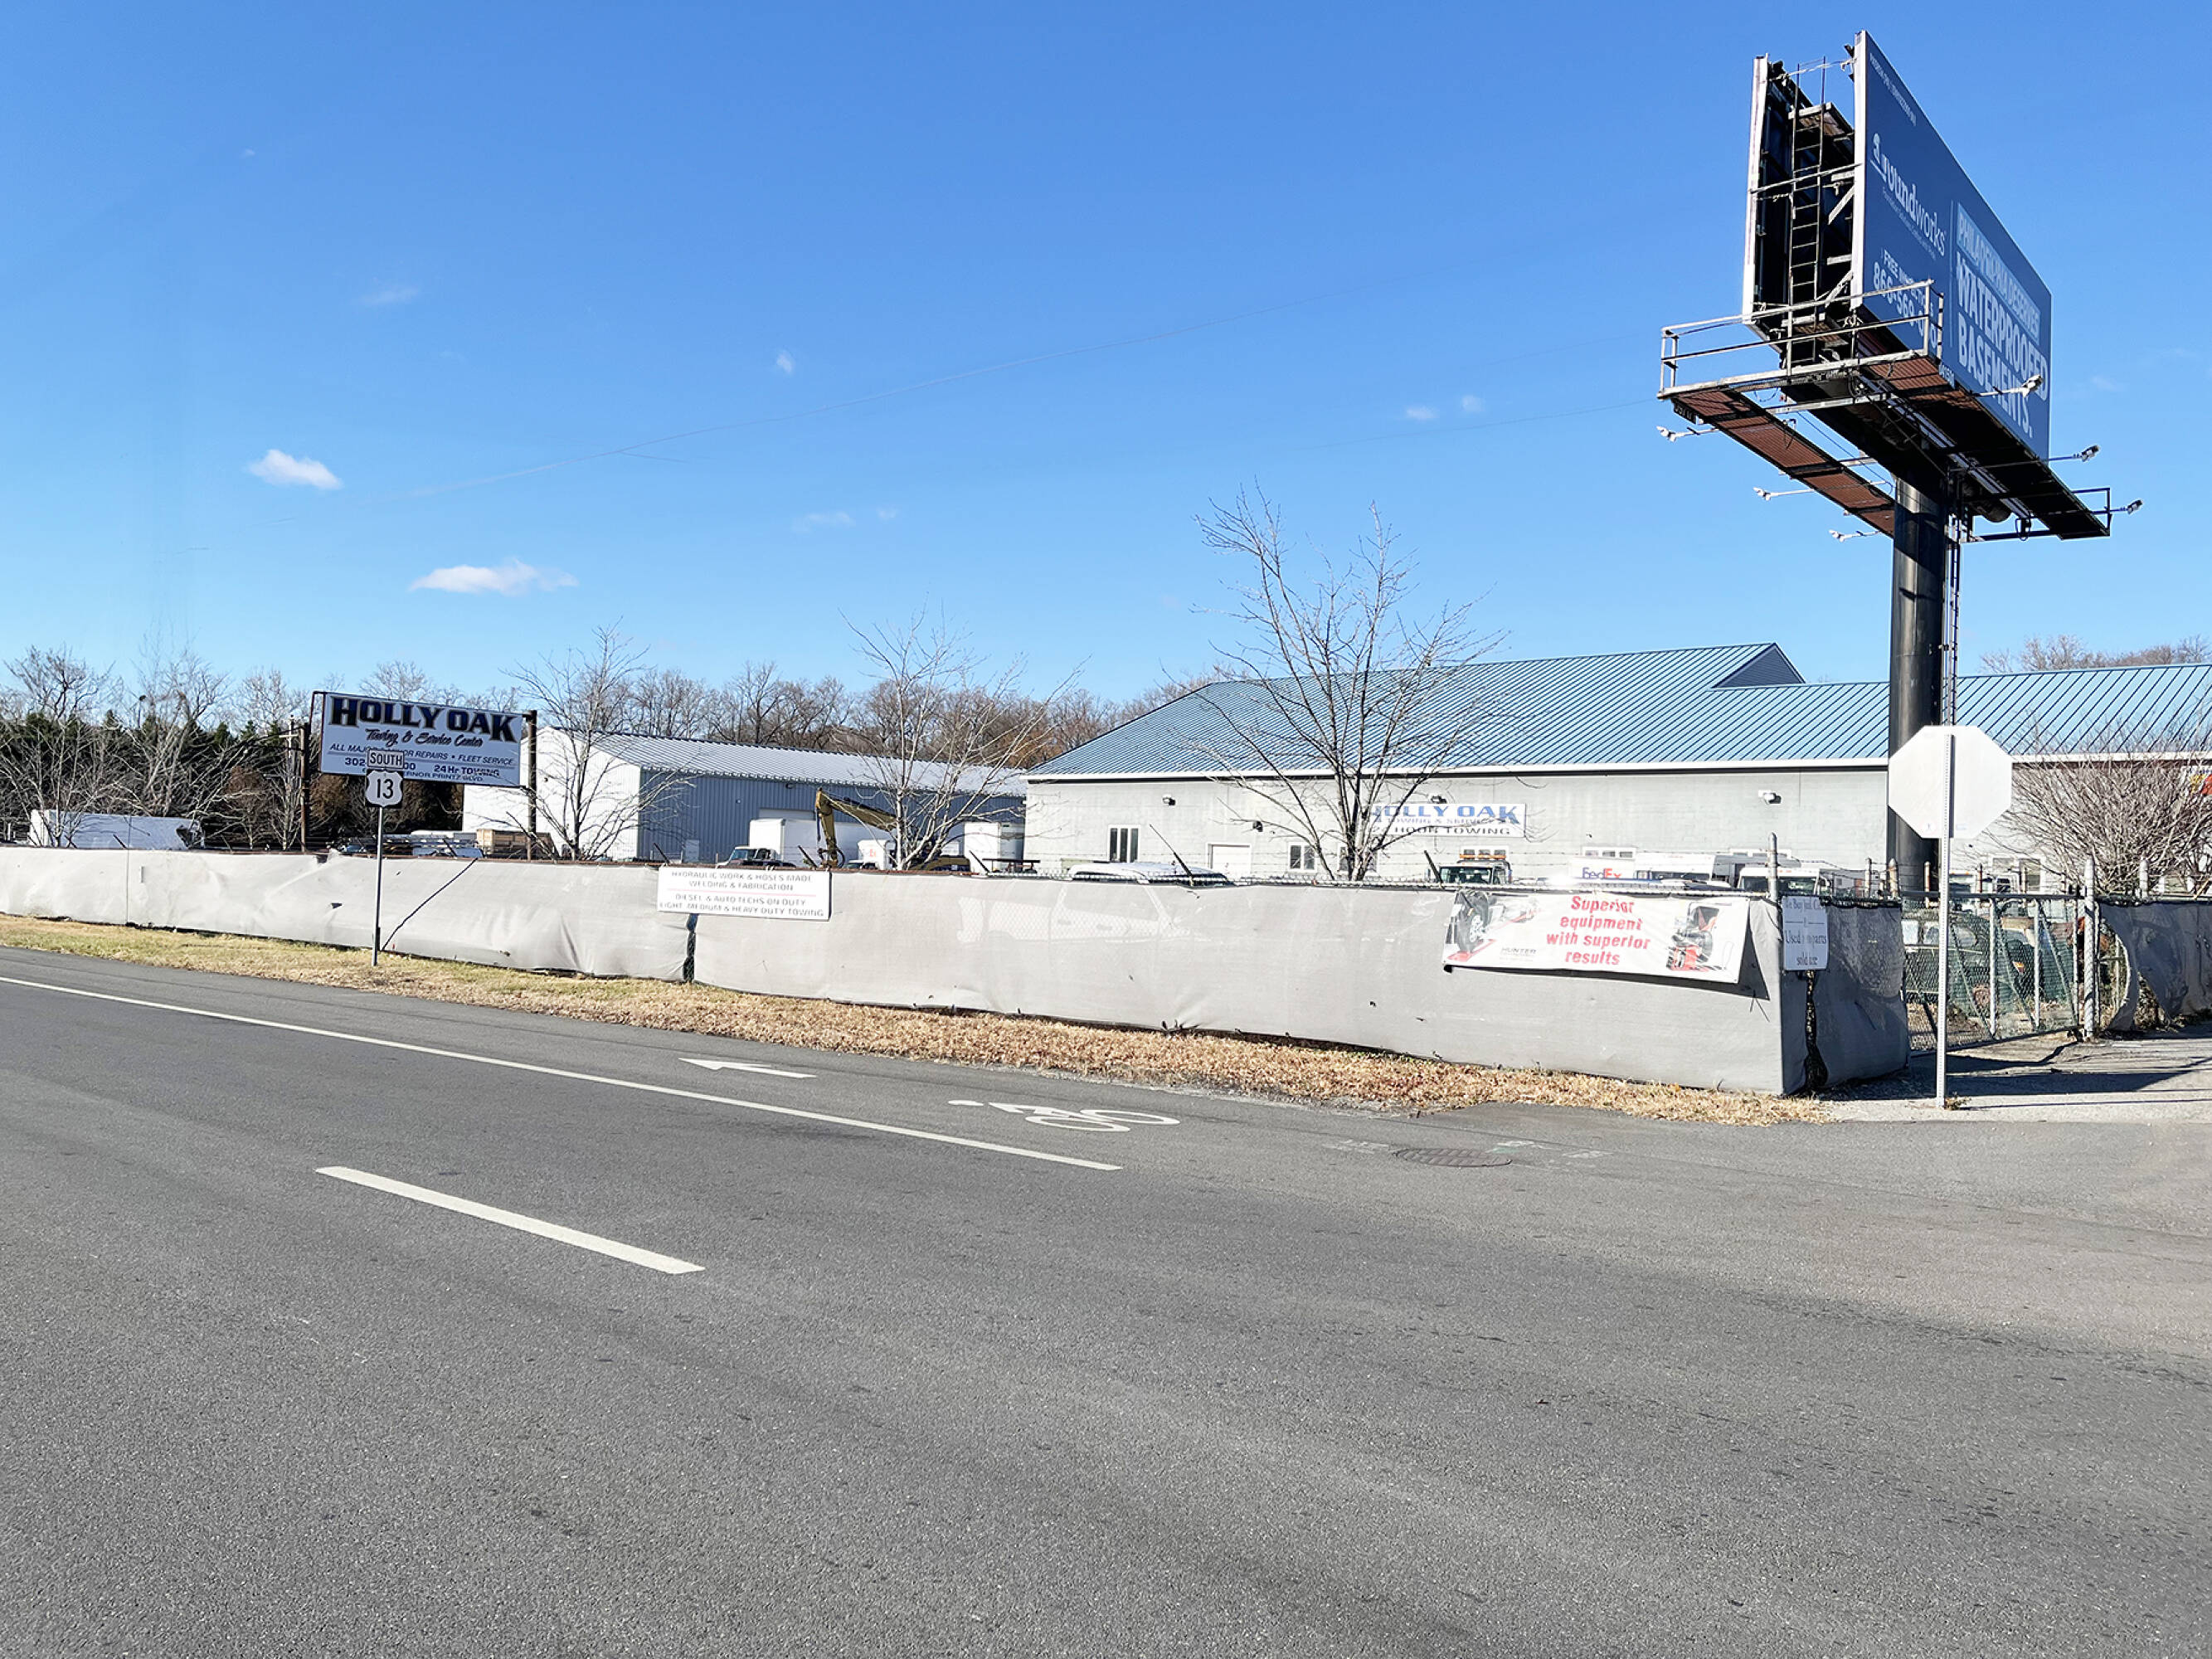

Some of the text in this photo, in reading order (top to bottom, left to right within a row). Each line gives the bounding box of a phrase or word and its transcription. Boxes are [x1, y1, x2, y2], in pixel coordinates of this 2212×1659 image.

[1957, 252, 2048, 402] WATERPROOFED
[330, 696, 518, 743] HOLLY OAK
[365, 728, 484, 747] Towing & Service Center
[330, 743, 344, 752] ALL
[370, 752, 403, 766] SOUTH
[416, 751, 448, 760] REPAIRS
[458, 754, 481, 763] FLEET
[483, 757, 514, 765] SERVICE
[377, 779, 393, 799] 13
[1457, 806, 1520, 825] OAK
[672, 871, 717, 879] HYDRAULIC
[1582, 867, 1622, 878] FedEx
[738, 883, 794, 891] FABRICATION
[1571, 895, 1635, 913] Superior
[788, 908, 824, 917] TOWING
[1559, 915, 1643, 932] equipment
[1546, 932, 1650, 950] with superior
[1565, 951, 1620, 965] results
